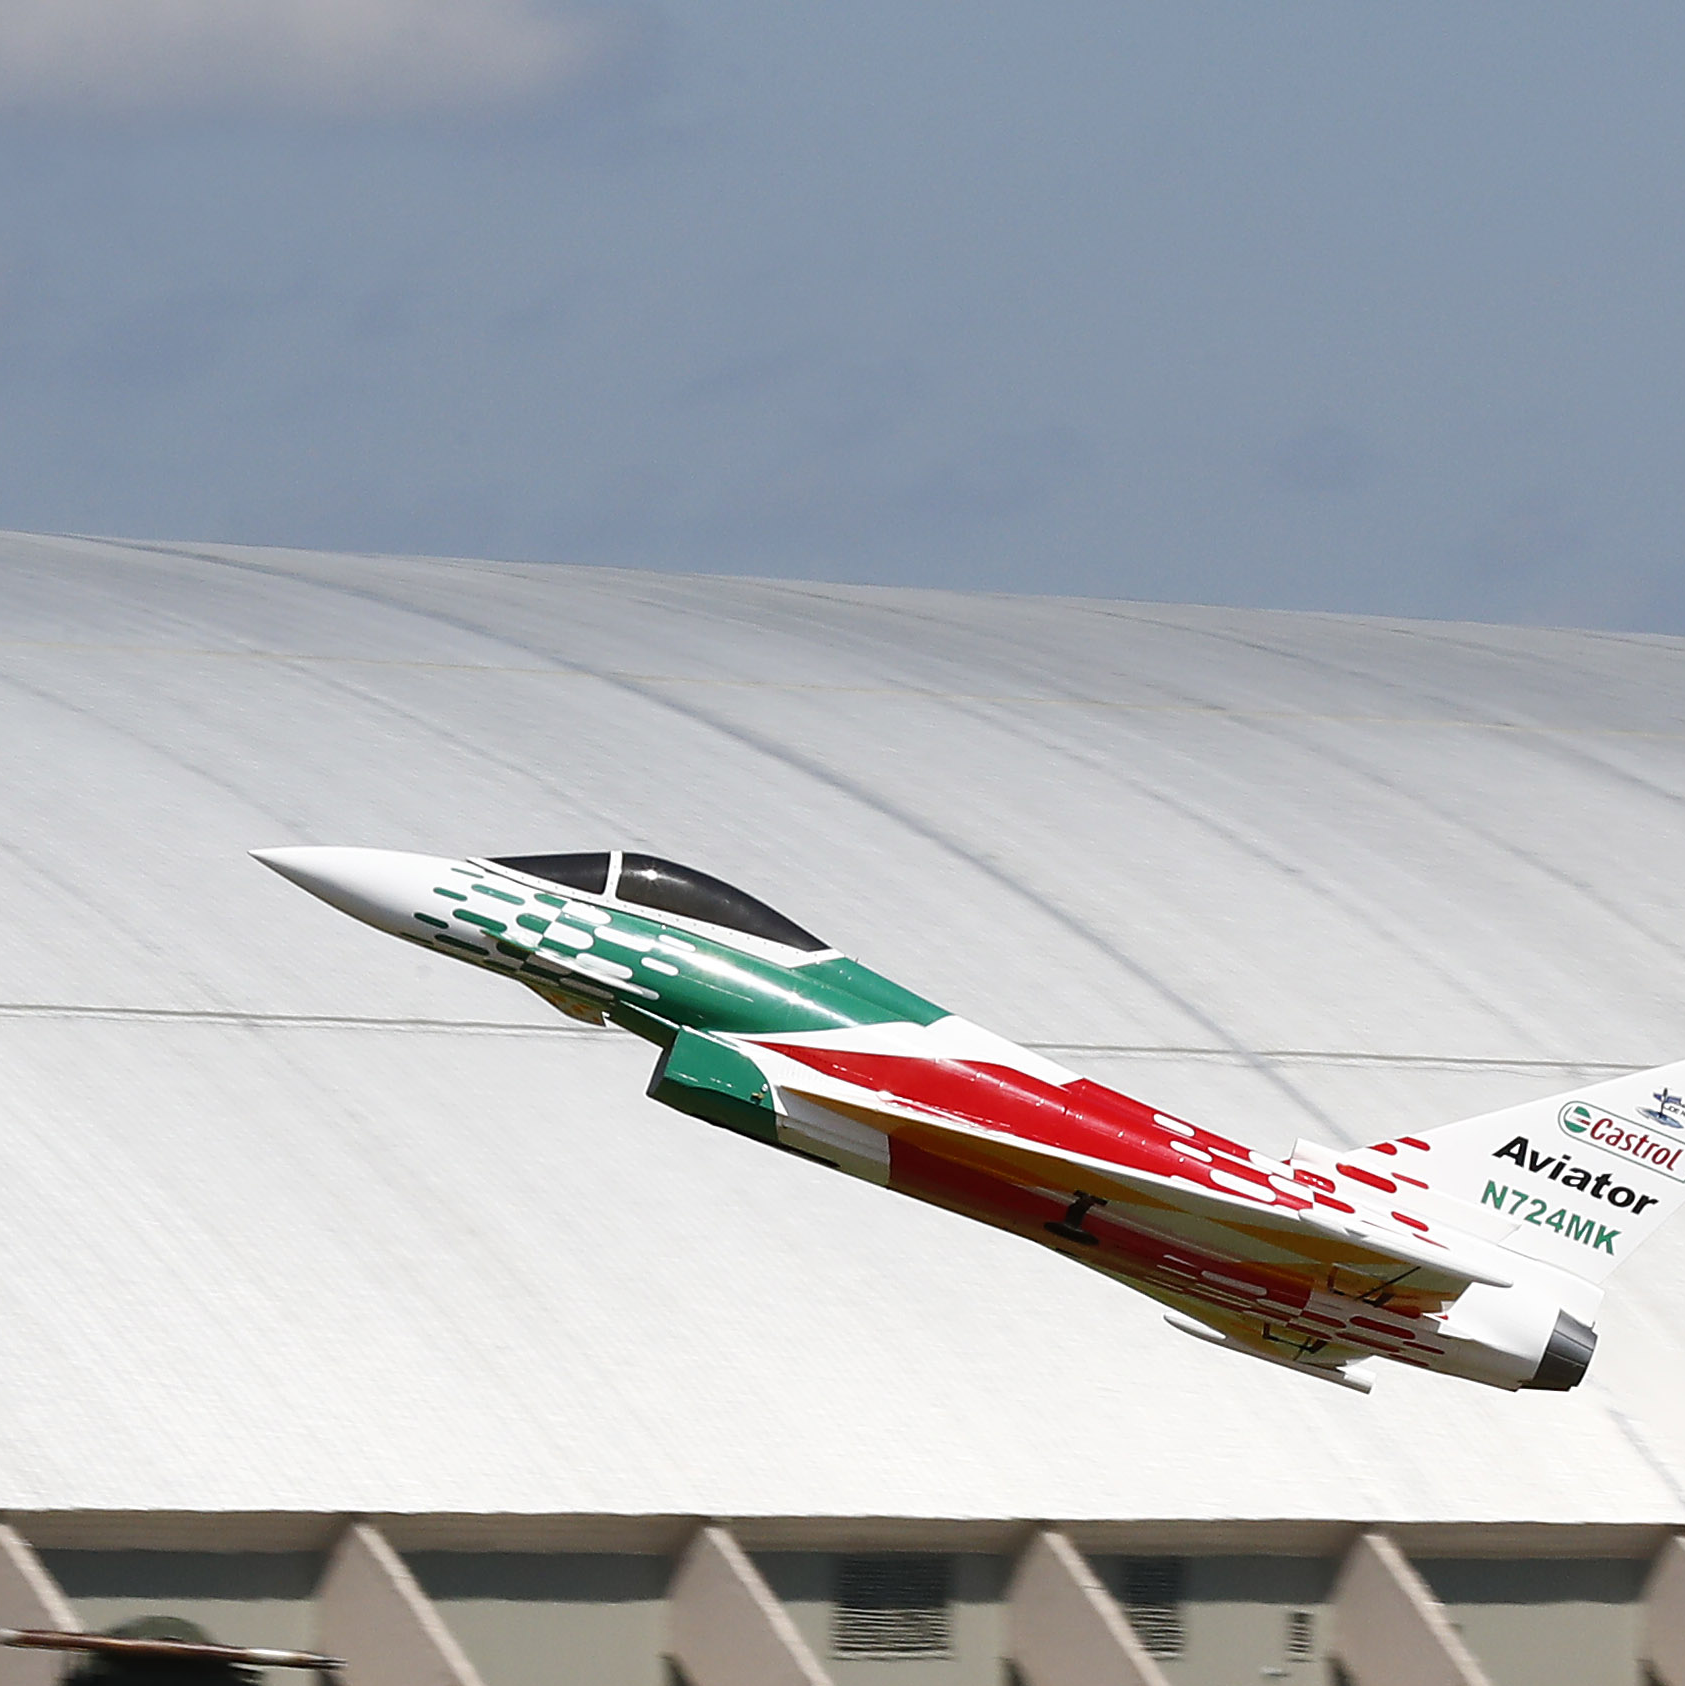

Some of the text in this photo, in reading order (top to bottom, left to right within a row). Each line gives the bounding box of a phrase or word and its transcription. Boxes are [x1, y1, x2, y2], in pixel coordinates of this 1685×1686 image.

[1492, 1135, 1660, 1216] Aviator
[1589, 1117, 1684, 1172] Castrol
[1480, 1179, 1623, 1256] N724MK
